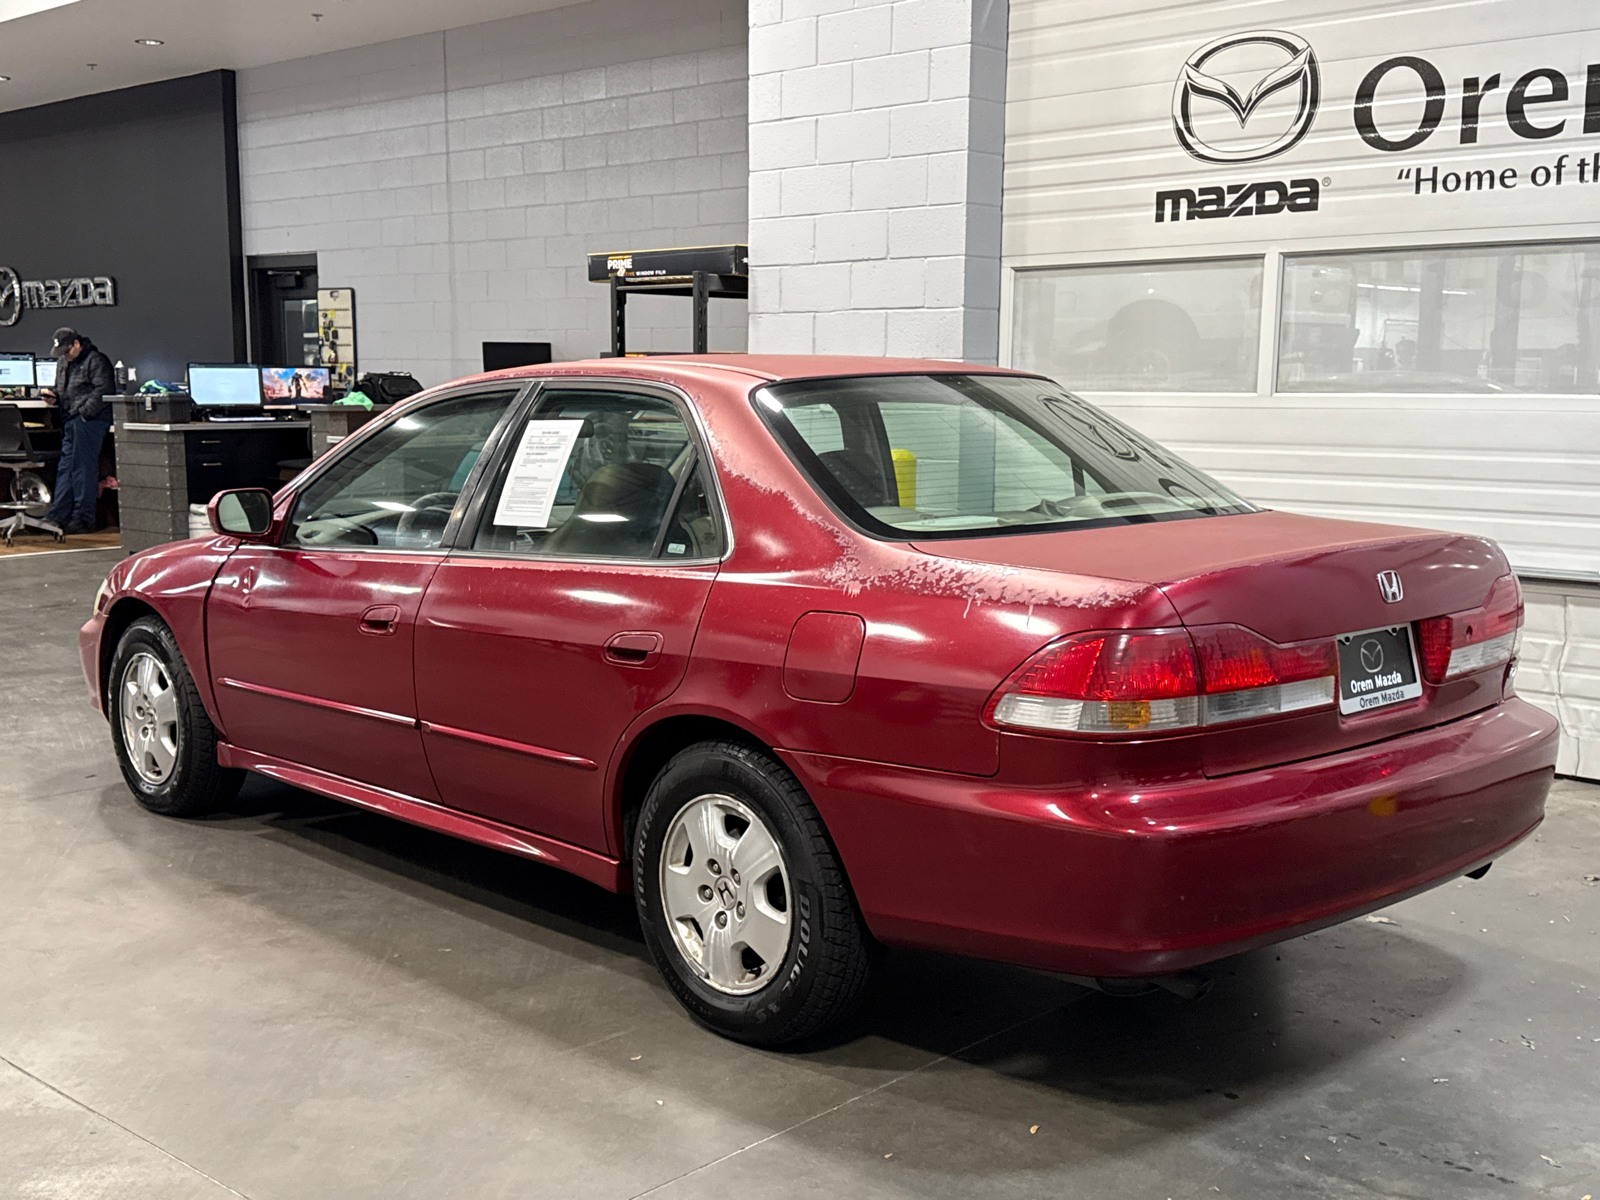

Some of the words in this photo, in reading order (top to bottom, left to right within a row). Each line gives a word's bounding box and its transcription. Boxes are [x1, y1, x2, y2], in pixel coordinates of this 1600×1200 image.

[1530, 154, 1569, 187] of
[1155, 178, 1319, 223] mazda
[607, 259, 632, 269] PRIME
[21, 277, 114, 308] mazda
[1350, 678, 1374, 694] Orem
[1374, 670, 1402, 688] Mazda
[1359, 696, 1380, 708] Orem
[1380, 690, 1405, 703] Mazda
